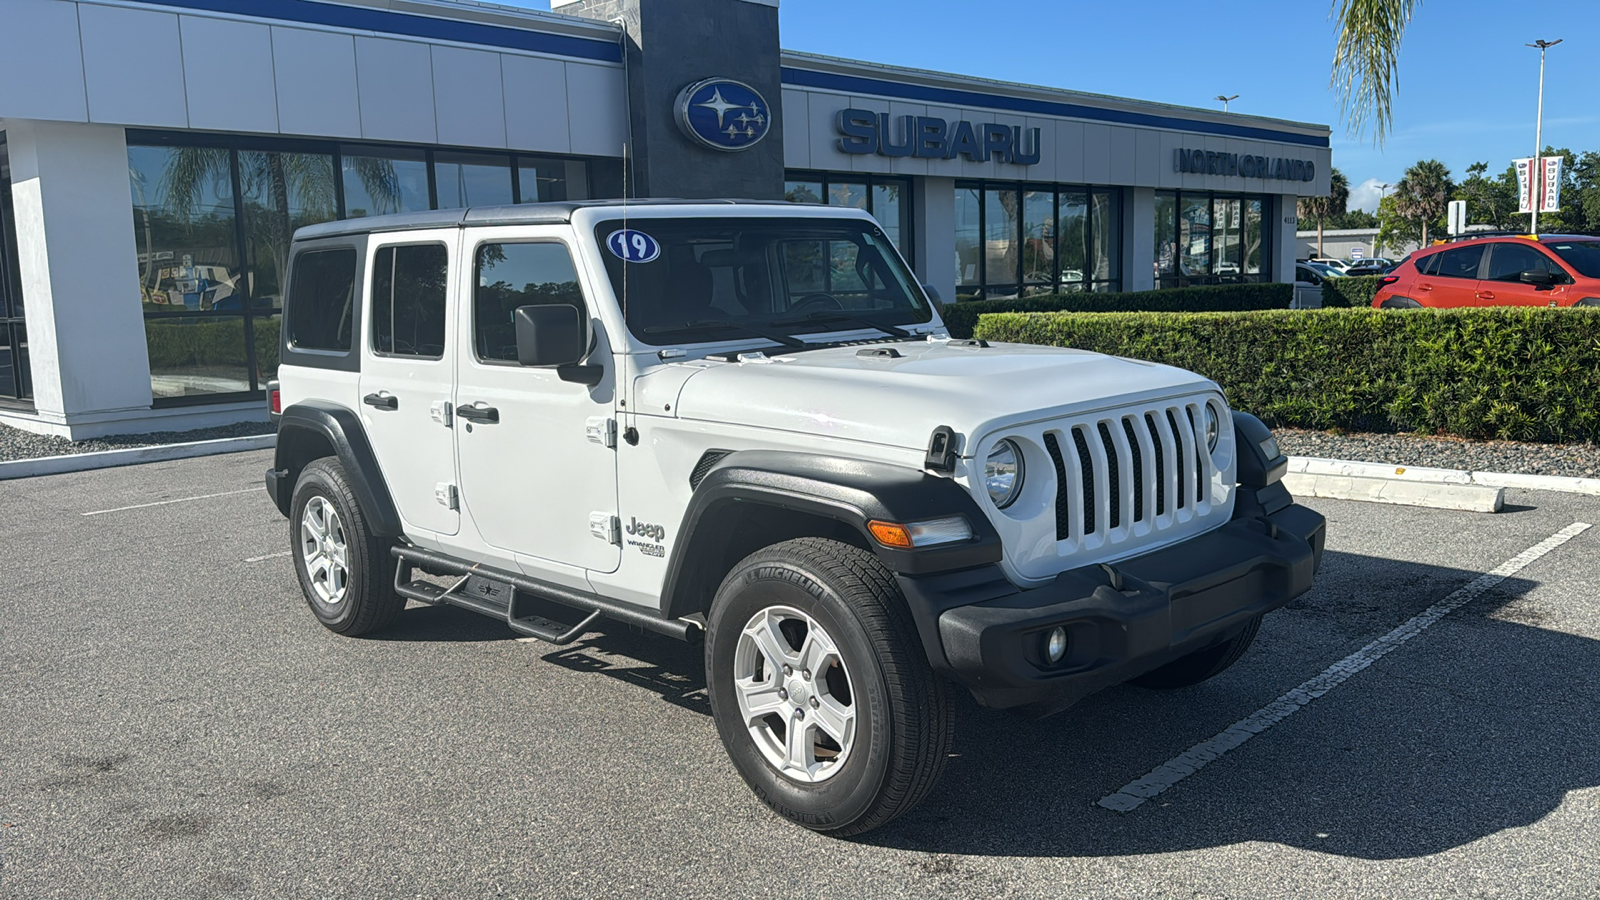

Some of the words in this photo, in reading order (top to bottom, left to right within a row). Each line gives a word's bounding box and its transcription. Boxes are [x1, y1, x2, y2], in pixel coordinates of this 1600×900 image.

[837, 108, 1041, 165] SUBARU
[1174, 148, 1238, 176] NORTH
[1239, 154, 1315, 182] ORLANDO
[1547, 168, 1556, 208] SUBARU
[617, 233, 647, 258] 19
[626, 516, 665, 543] Jeep
[758, 567, 823, 598] MICHELIN
